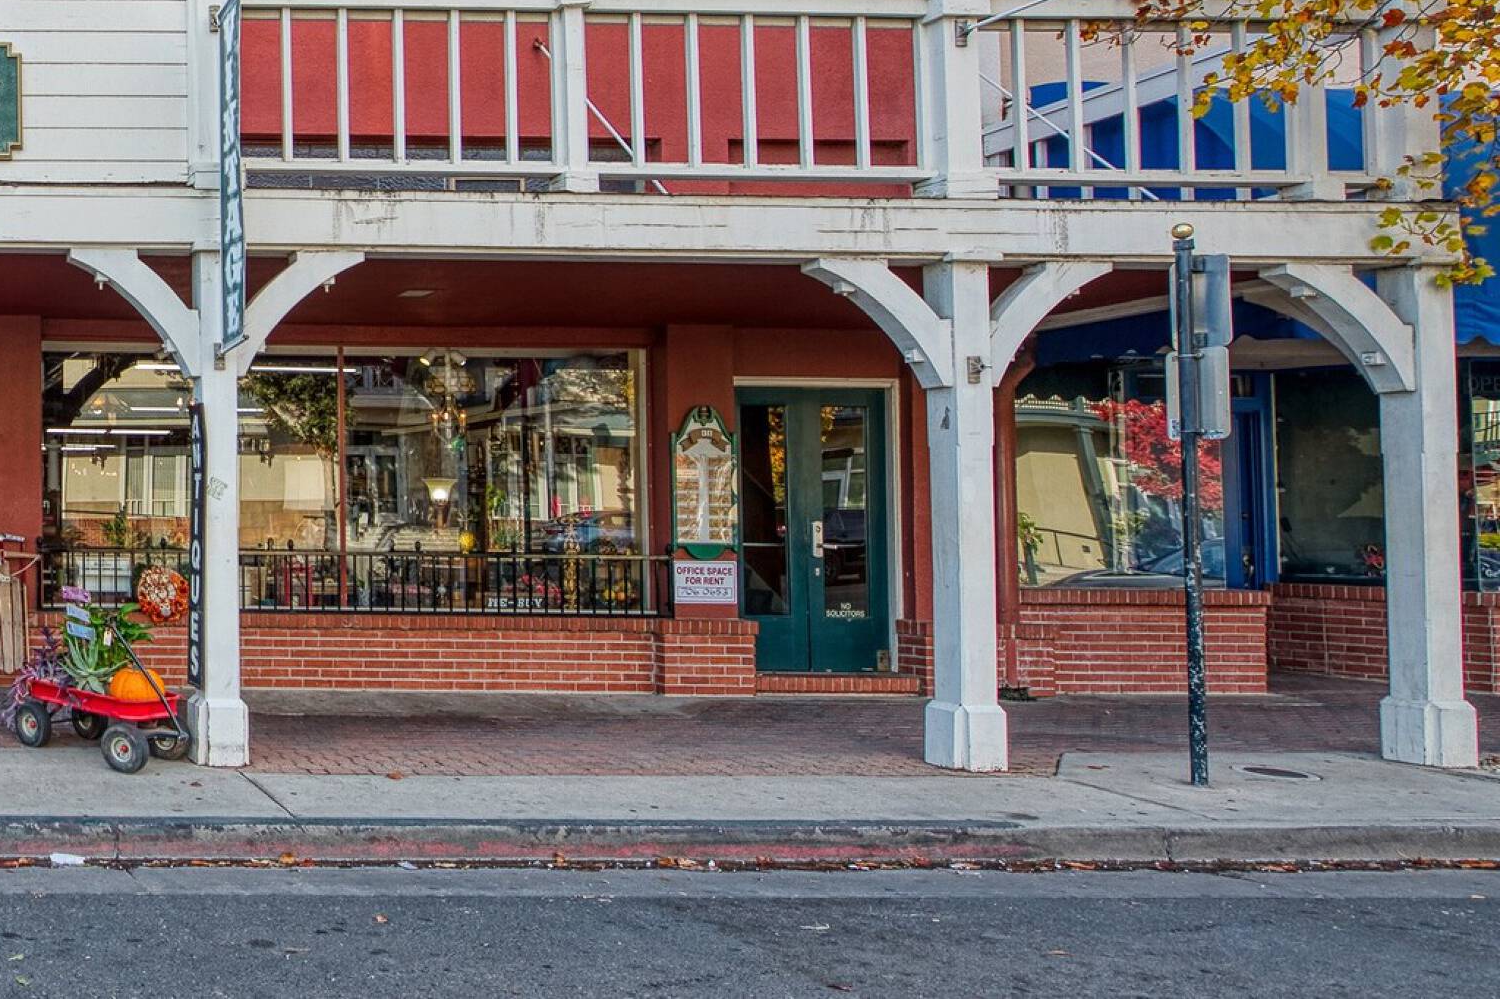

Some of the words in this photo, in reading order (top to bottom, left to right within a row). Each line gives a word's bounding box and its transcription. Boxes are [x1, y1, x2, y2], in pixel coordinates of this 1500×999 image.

[191, 415, 202, 677] ANTIQUES
[676, 566, 704, 575] OFFICE
[707, 566, 733, 576] SPACE
[685, 577, 702, 585] FOR
[703, 577, 725, 585] RENT
[840, 602, 852, 610] NO
